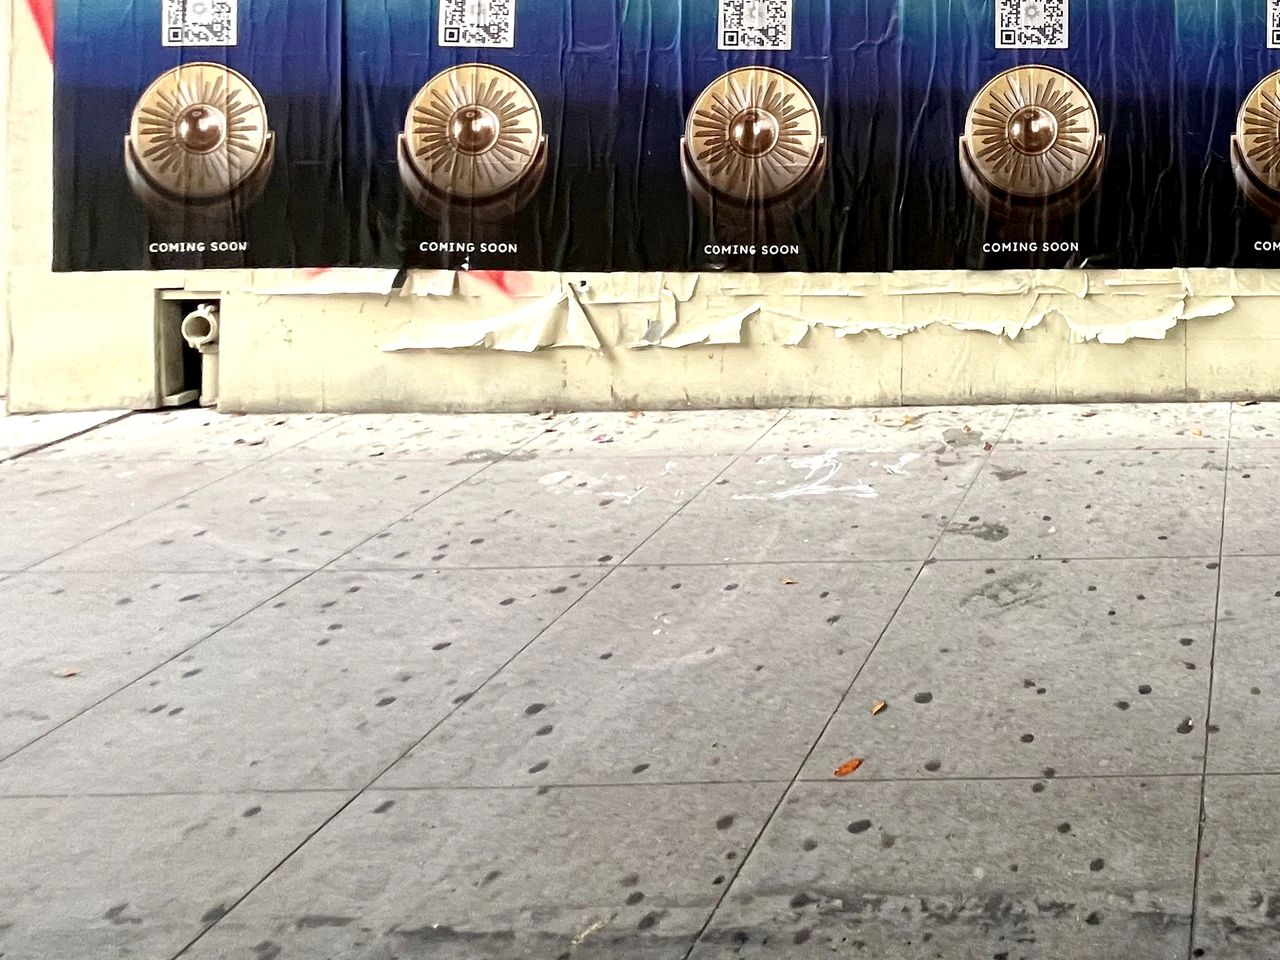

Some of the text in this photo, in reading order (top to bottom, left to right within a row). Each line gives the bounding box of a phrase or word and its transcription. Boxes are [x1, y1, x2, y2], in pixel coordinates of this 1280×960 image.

[149, 242, 247, 252] COMING SOON
[420, 242, 517, 253] COMING SOON
[704, 245, 799, 255] COMING SOON
[983, 242, 1078, 252] COMING SOON
